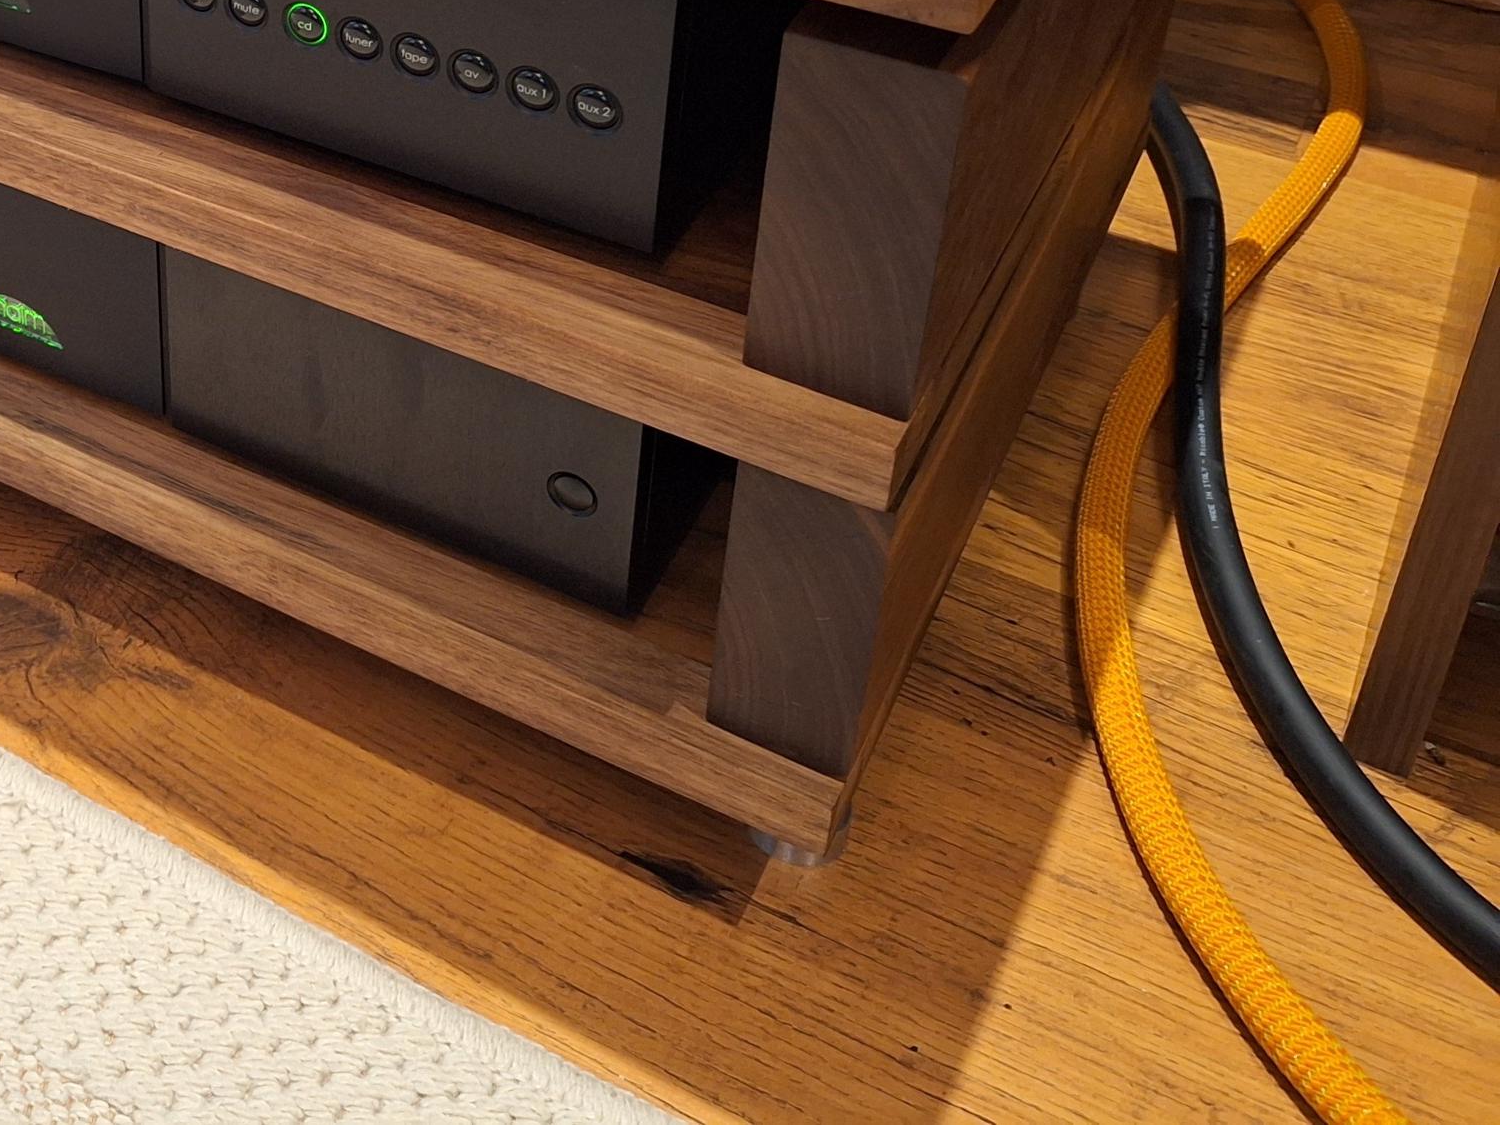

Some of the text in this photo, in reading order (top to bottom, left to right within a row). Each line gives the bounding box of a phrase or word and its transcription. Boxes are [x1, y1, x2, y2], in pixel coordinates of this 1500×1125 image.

[233, 2, 260, 15] mute
[297, 21, 312, 32] cd
[345, 31, 374, 48] tuner
[401, 49, 428, 65] tape
[464, 69, 480, 79] av
[516, 83, 547, 98] aux 1
[578, 101, 611, 118] aux 2
[1206, 491, 1214, 500] IN
